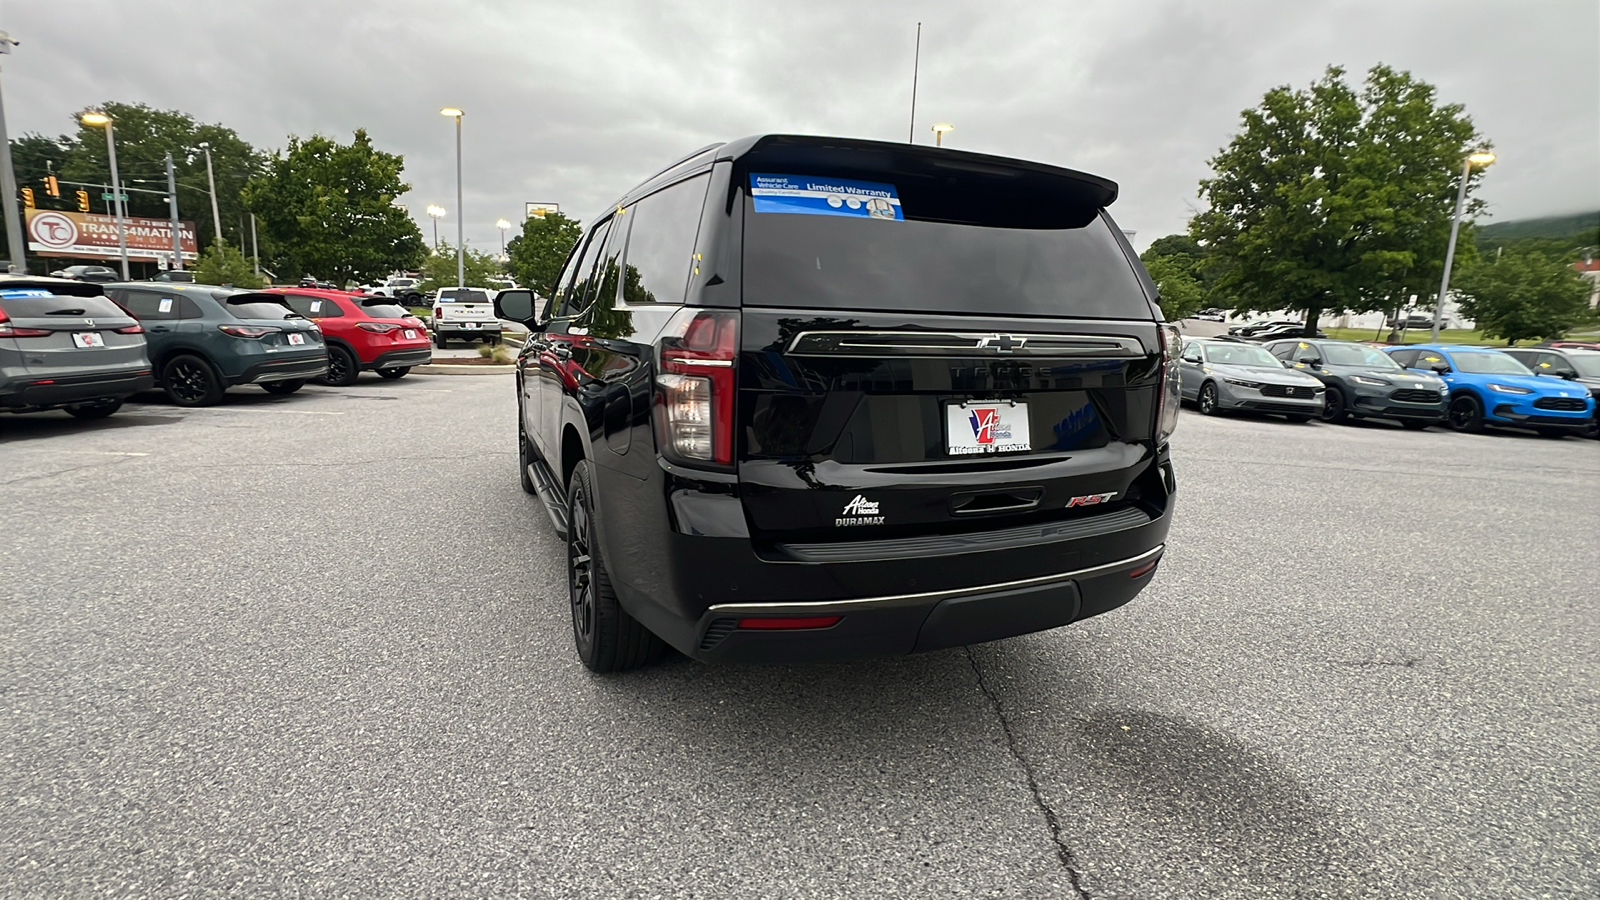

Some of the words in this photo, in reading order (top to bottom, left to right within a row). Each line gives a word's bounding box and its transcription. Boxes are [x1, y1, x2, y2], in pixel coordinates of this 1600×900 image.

[806, 183, 845, 193] Limited
[845, 186, 892, 198] Warranty
[948, 446, 985, 455] Altoona
[997, 444, 1032, 452] HONDA
[1064, 491, 1118, 508] RST
[835, 516, 885, 527] DURAMAX
